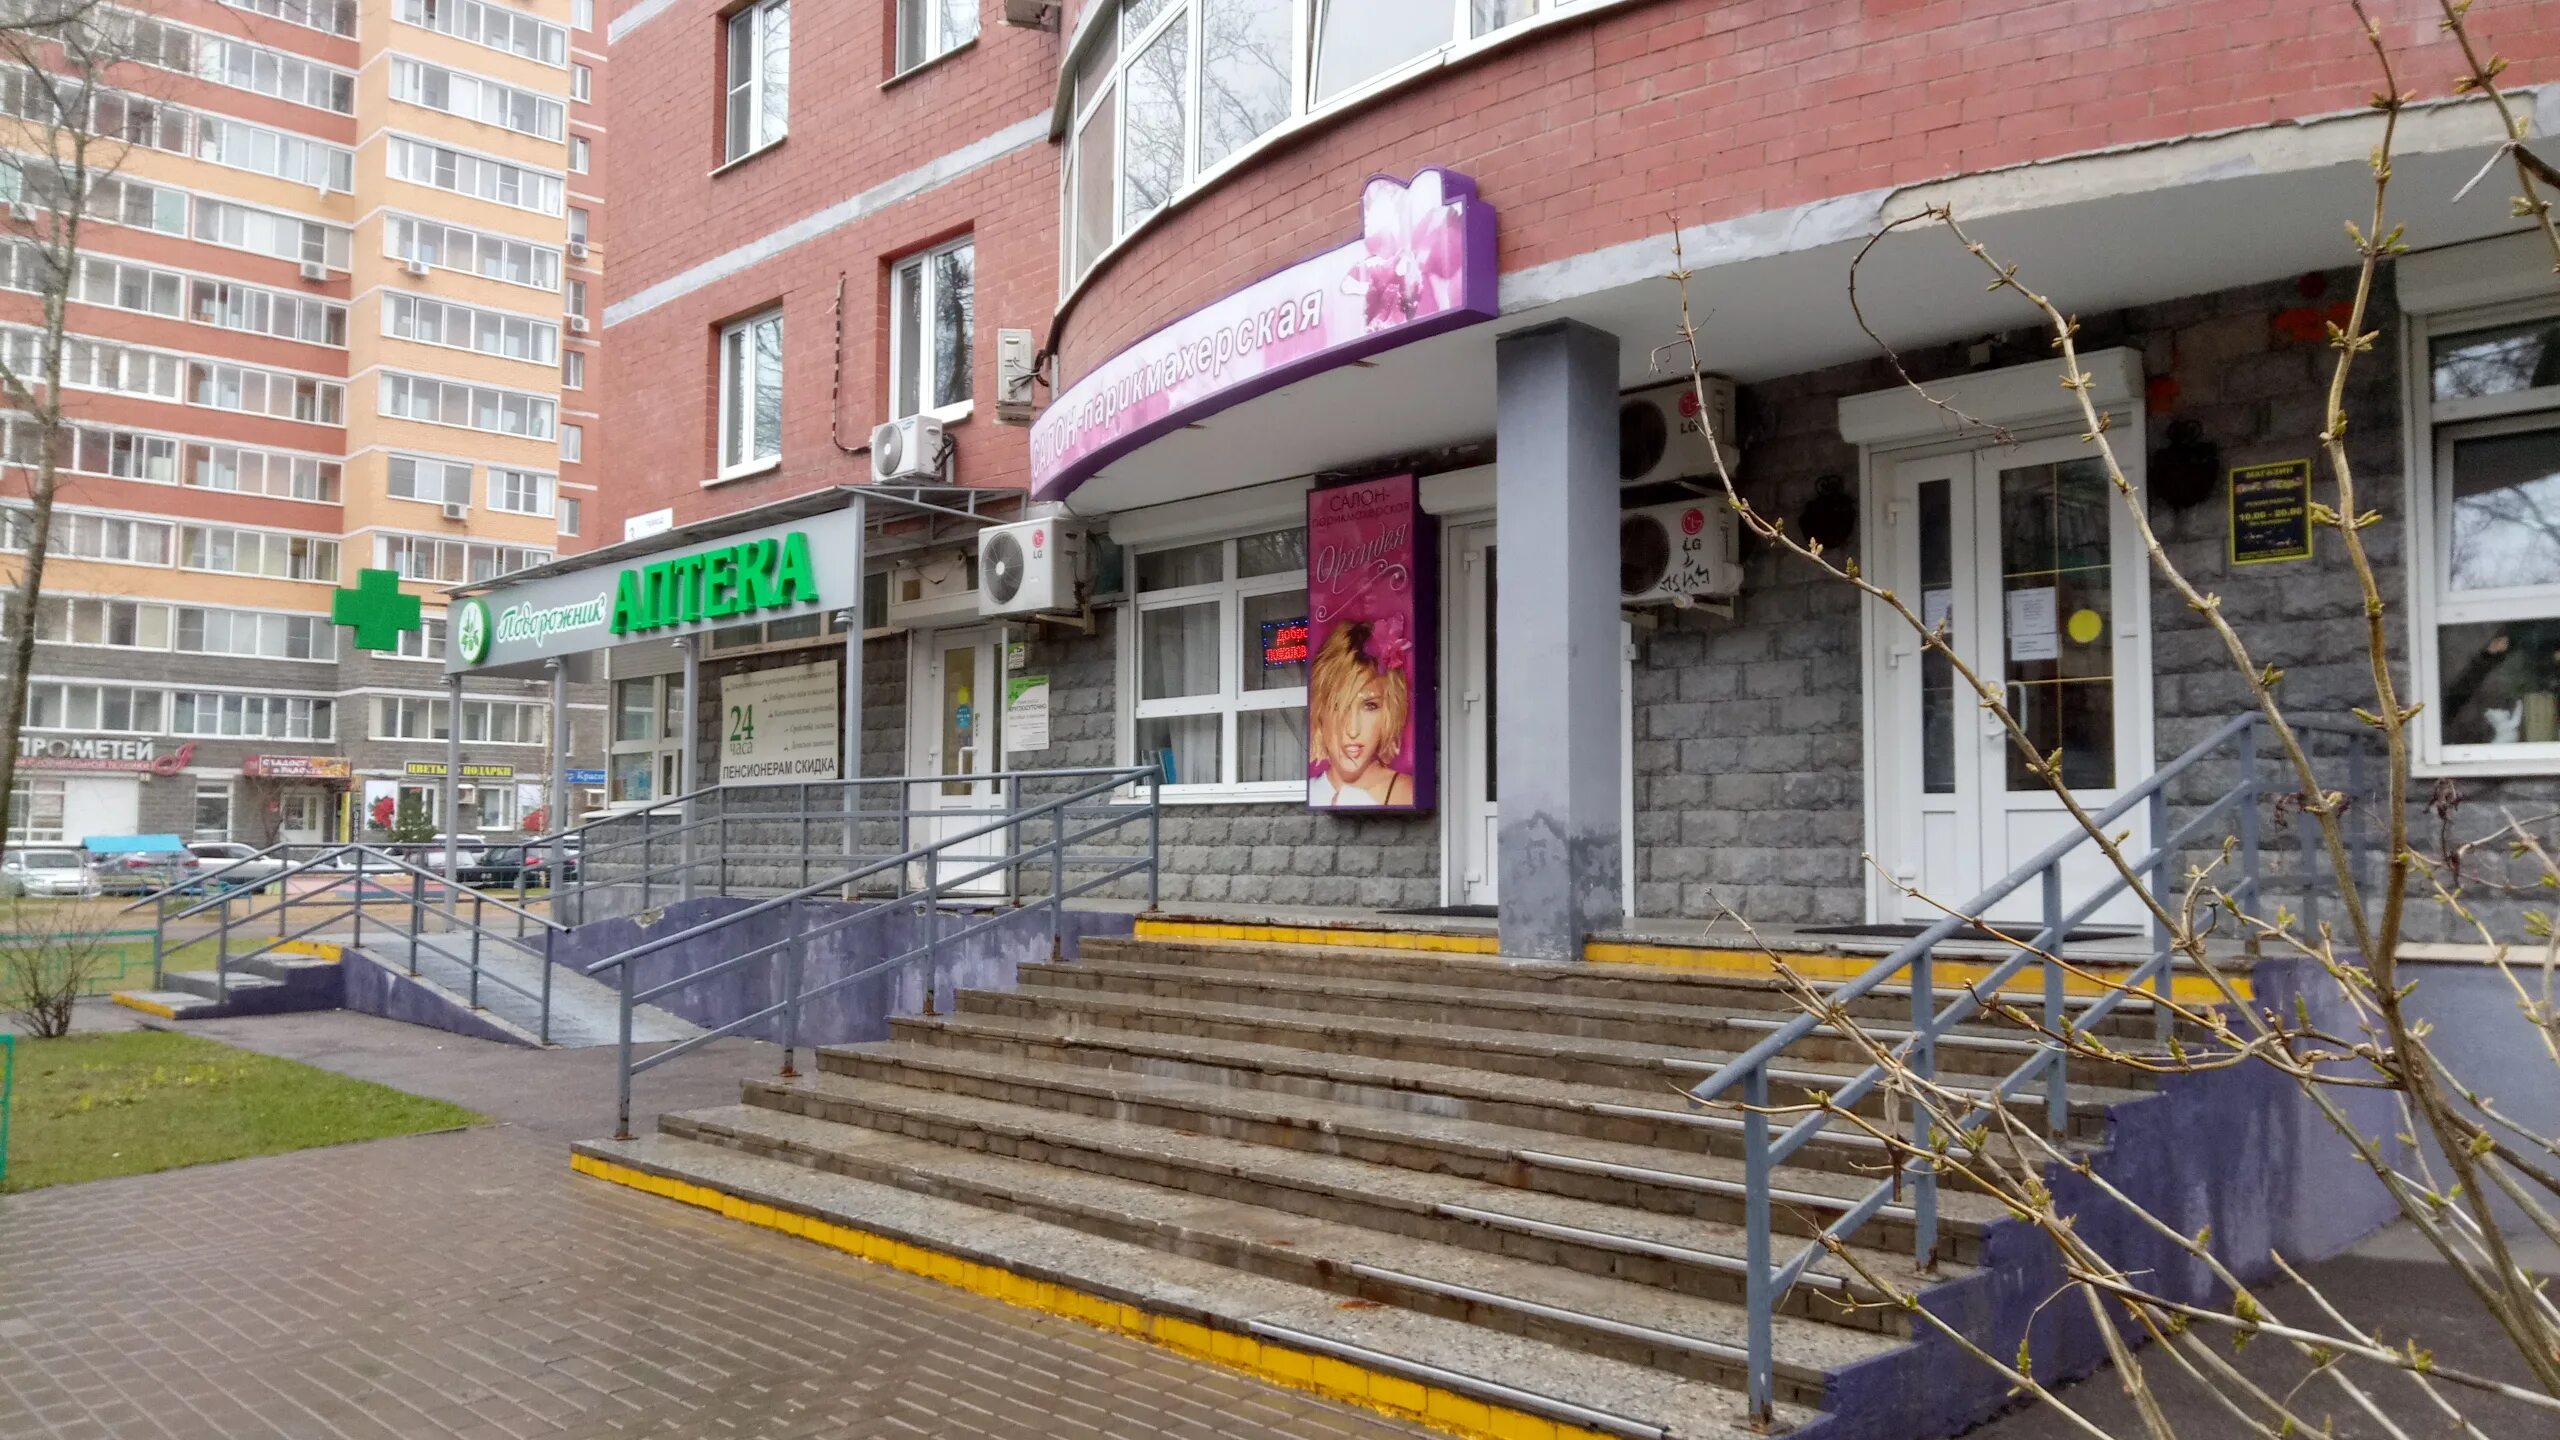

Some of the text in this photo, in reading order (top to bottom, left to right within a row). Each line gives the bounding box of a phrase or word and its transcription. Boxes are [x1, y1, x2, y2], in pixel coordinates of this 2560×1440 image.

[1031, 289, 1324, 478] САЛОН-парикмахерская
[1680, 421, 1698, 435] LG
[1329, 487, 1391, 512] САЛОН-
[1312, 502, 1410, 529] парикмахерская
[1032, 549, 1043, 560] LG
[1683, 537, 1702, 551] LG
[1316, 521, 1408, 594] Орхидея
[609, 531, 820, 635] АПТЕКА
[497, 592, 607, 648] Подорожник
[730, 704, 754, 741] 24
[730, 741, 753, 756] часа
[408, 763, 512, 777] ЦВЕТЫ ПОДАРКИ
[723, 757, 835, 779] ПЕНСИОНЕРАМ СКИДКА
